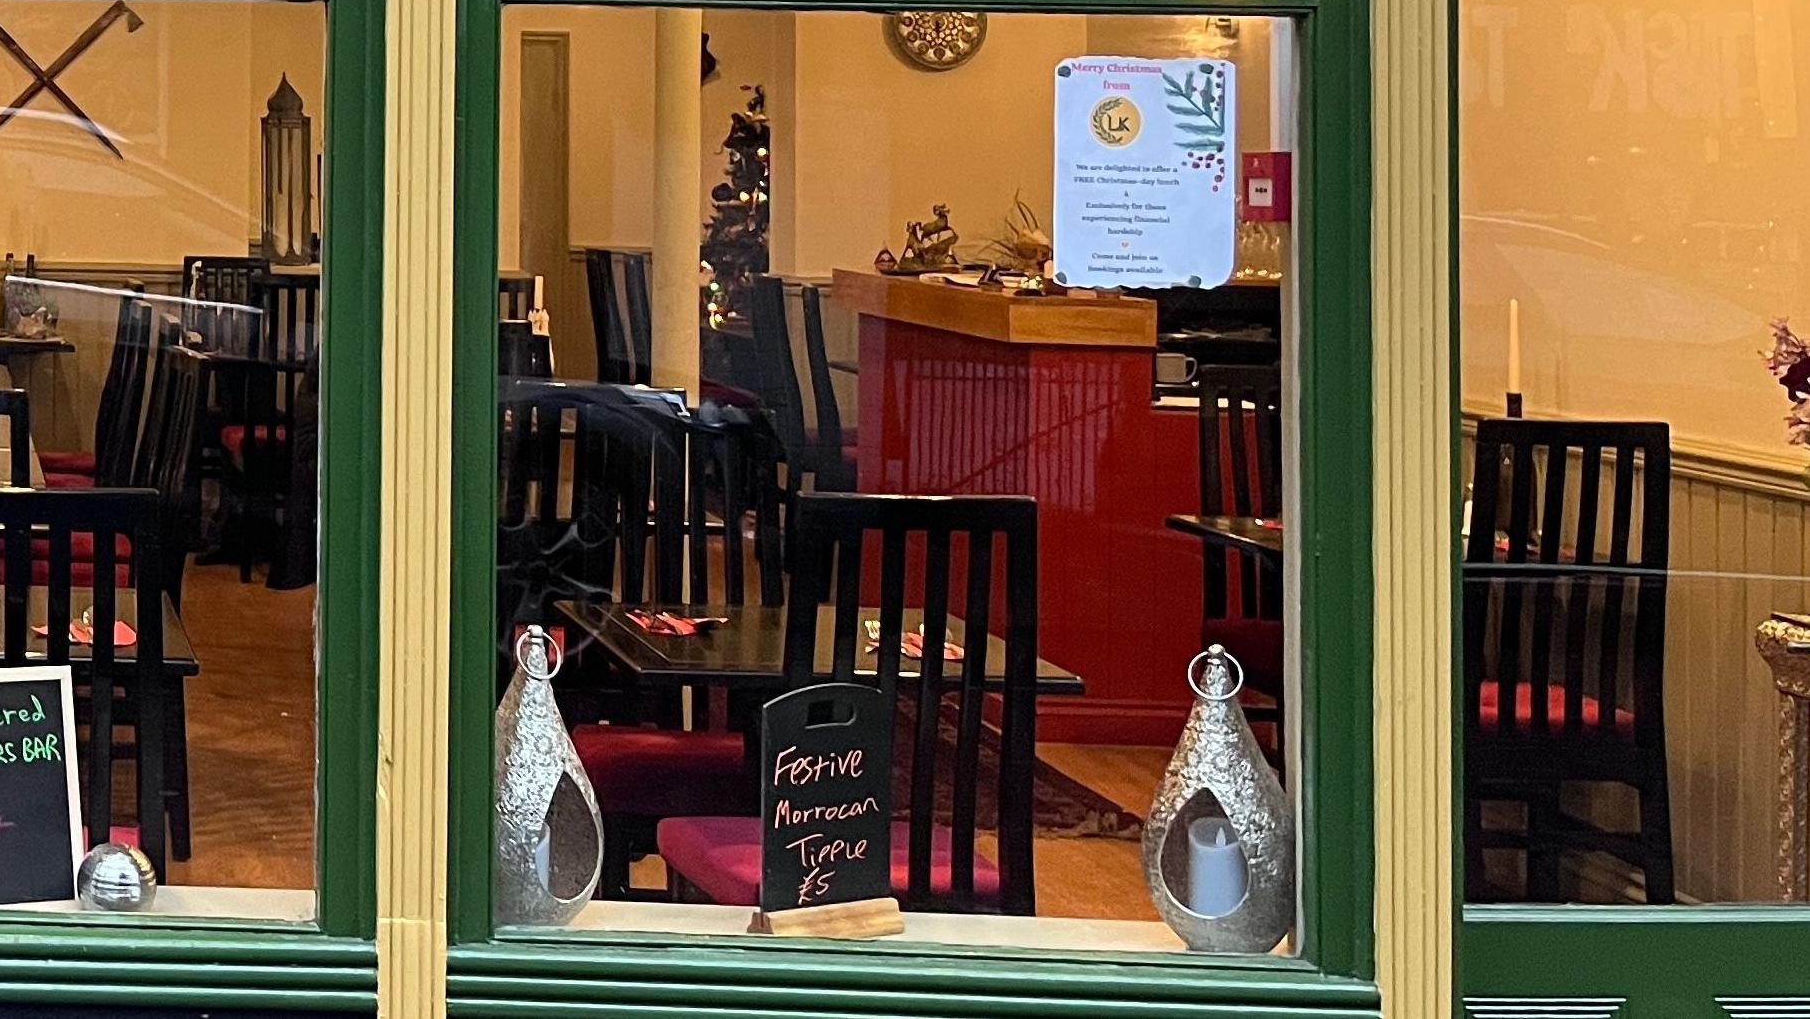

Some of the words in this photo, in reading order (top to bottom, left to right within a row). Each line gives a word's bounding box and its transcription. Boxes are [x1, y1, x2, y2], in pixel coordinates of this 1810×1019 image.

[1071, 62, 1104, 74] Merry
[1107, 63, 1162, 74] Christmas
[1103, 80, 1131, 91] from
[21, 733, 62, 763] BAR
[774, 746, 864, 787] Festive
[774, 796, 880, 830] Morrocan
[797, 867, 836, 906] £5
